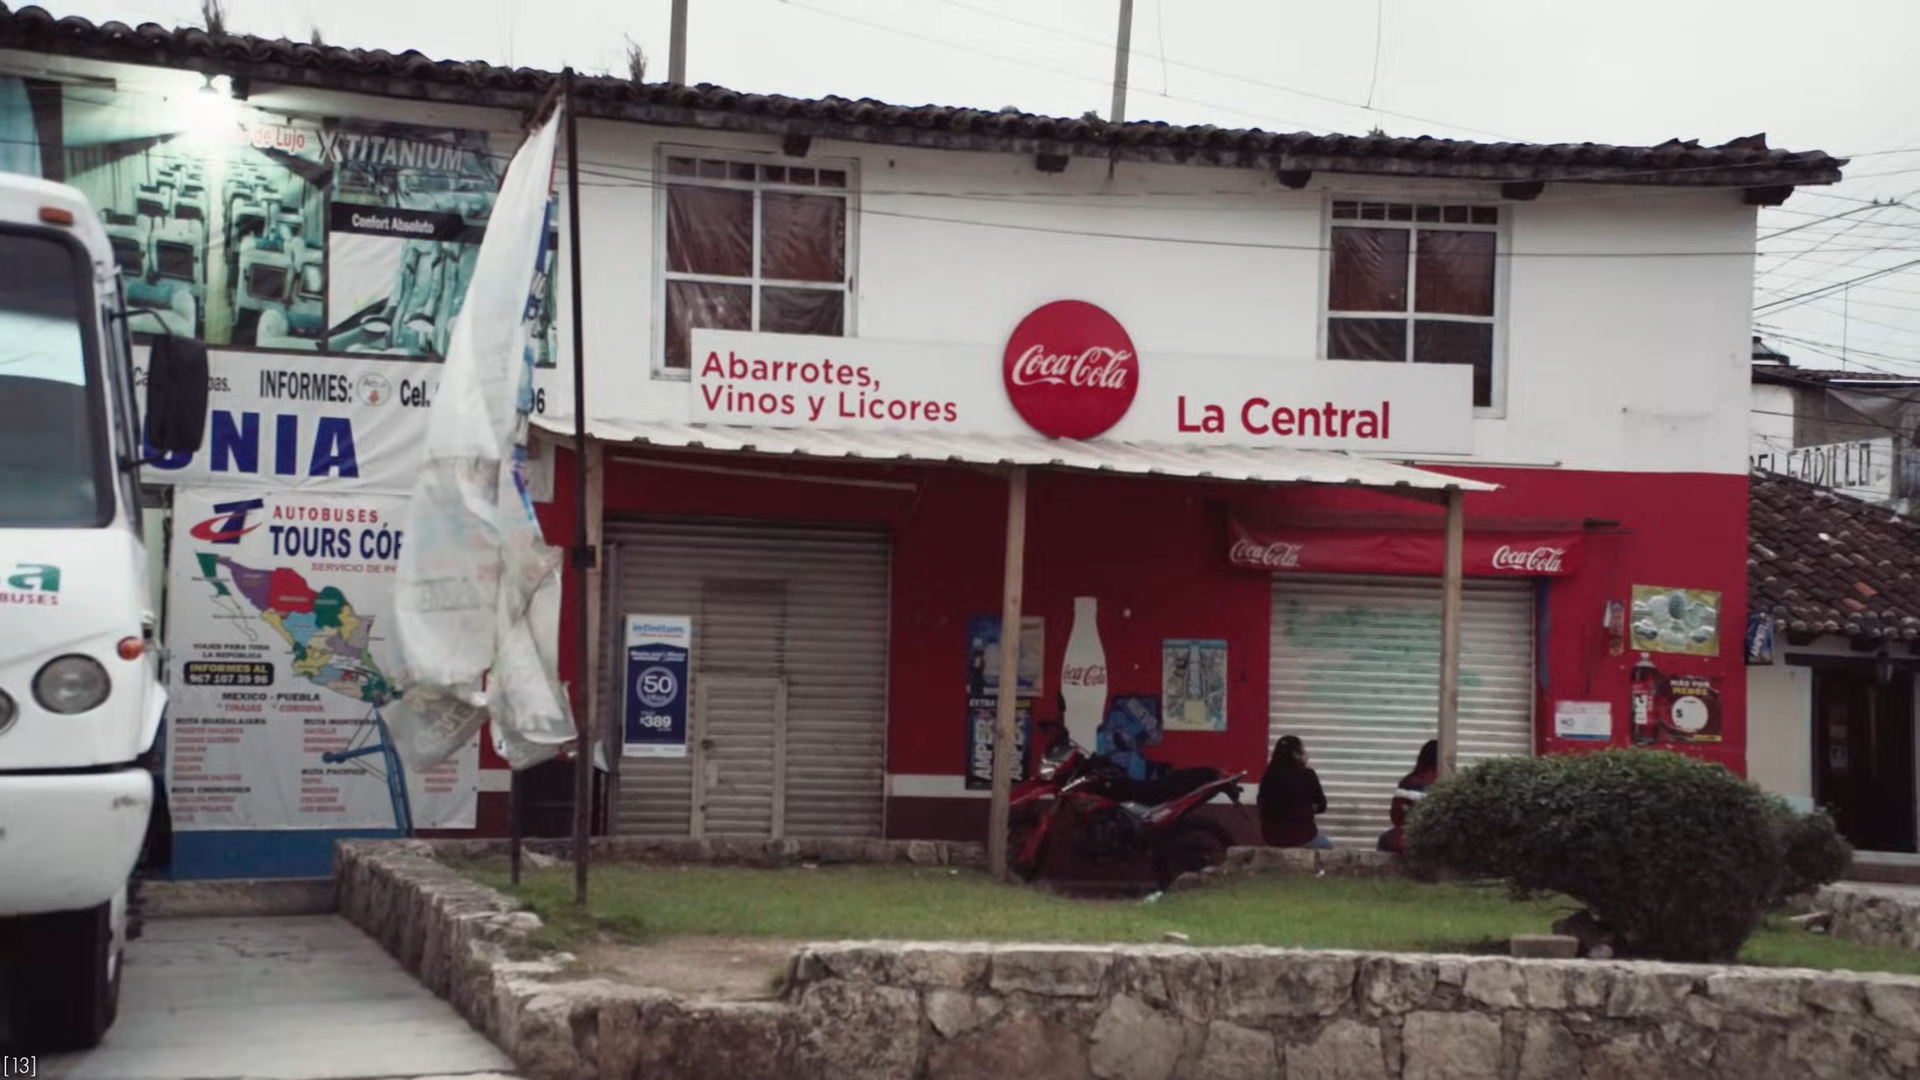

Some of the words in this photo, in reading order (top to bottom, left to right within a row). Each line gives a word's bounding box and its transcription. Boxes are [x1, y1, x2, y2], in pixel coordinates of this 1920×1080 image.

[276, 126, 306, 153] Lujo
[351, 213, 389, 230] Confort
[391, 216, 435, 234] Absoluto
[700, 351, 881, 392] Abarrotes,
[1010, 344, 1134, 390] Coca-Cola
[260, 370, 353, 404] INFORMES:
[400, 379, 431, 408] Cel.
[701, 384, 796, 416] Vinos
[806, 394, 826, 422] y
[838, 391, 959, 423] Licores
[1176, 396, 1226, 434] La
[1240, 396, 1391, 440] Central
[272, 505, 379, 523] AUTOBUSES
[269, 525, 352, 558] TOURS
[1230, 538, 1305, 568] Coca-Cola
[1492, 544, 1568, 572] Coca-Cola
[189, 664, 251, 673] INFORMES
[253, 665, 269, 673] AL
[222, 692, 267, 701] MEXICO
[276, 693, 321, 702] PUEBLA
[643, 675, 672, 694] 50
